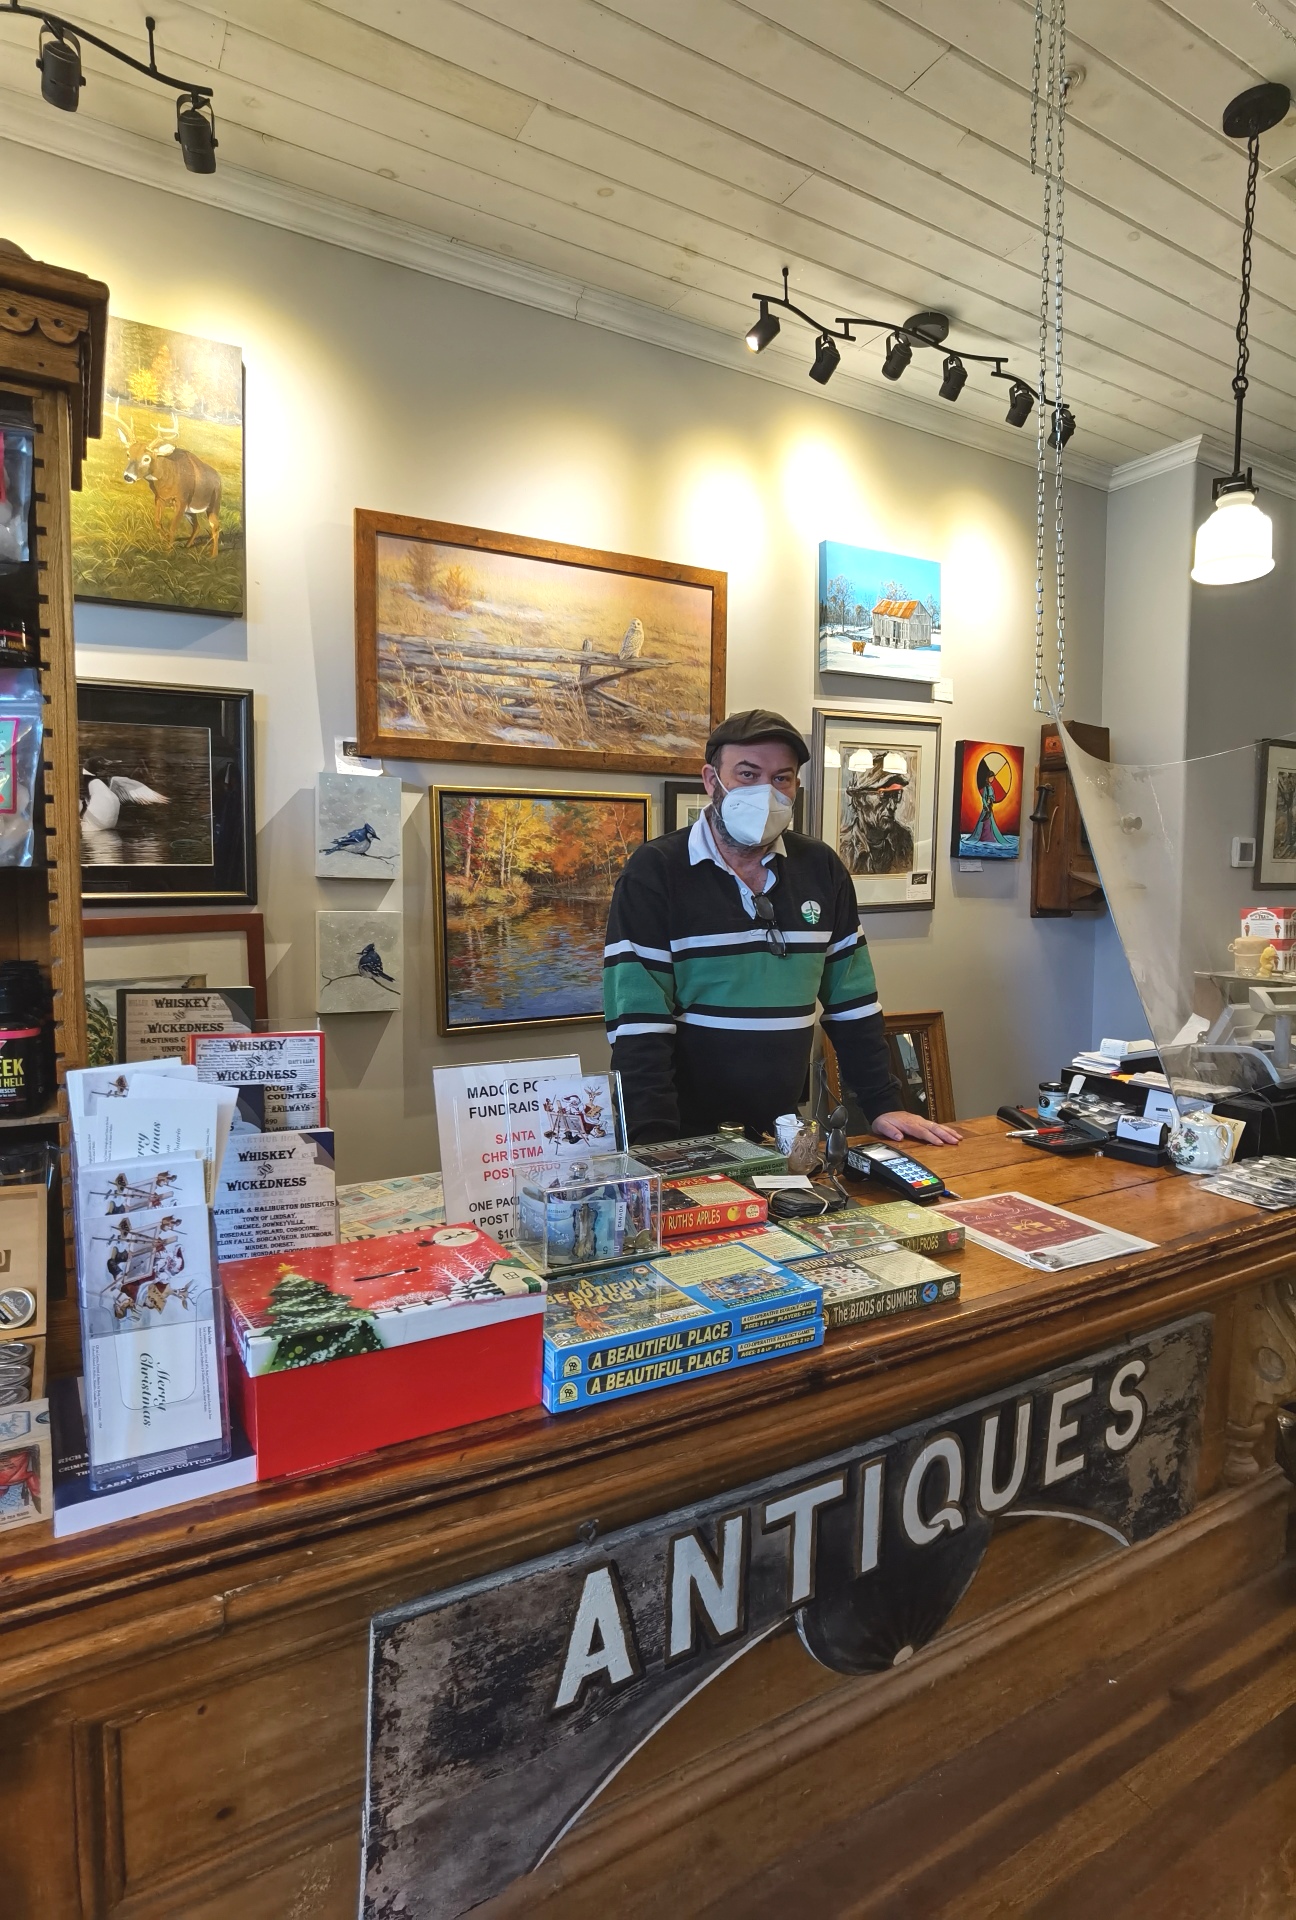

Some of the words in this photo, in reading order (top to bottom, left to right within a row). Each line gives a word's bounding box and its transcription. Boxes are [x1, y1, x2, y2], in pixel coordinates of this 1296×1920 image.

[154, 997, 211, 1008] WHISKEY
[147, 1022, 224, 1033] WICKEDNESS
[229, 1039, 287, 1052] WHISKEY
[4, 1077, 25, 1087] HELL
[217, 1069, 297, 1081] WICKEDNESS
[495, 1130, 536, 1144] SANTA
[238, 1148, 296, 1162] WHISKEY
[482, 1146, 543, 1164] CHRSTMA
[226, 1177, 307, 1191] WICKEDNESS
[254, 1204, 299, 1212] HALIBURTON
[469, 1200, 493, 1212] ONE
[479, 1213, 509, 1227] POST
[668, 1213, 694, 1230] RUTH'S
[697, 1209, 721, 1226] APPLES
[801, 1256, 835, 1270] BIRDS
[580, 1279, 594, 1290] A
[547, 1279, 646, 1305] BEAUTIFUL
[572, 1290, 635, 1309] PLACE
[833, 1306, 848, 1323] The
[850, 1299, 875, 1319] BIRDS
[876, 1295, 884, 1313] of
[886, 1289, 918, 1310] SUMMER
[591, 1352, 602, 1369] A
[607, 1334, 683, 1366] BEAUTIFUL
[687, 1322, 729, 1346] PLACE
[591, 1378, 601, 1394] A
[606, 1359, 683, 1391] BEAUTIFUL
[687, 1347, 730, 1371] PLACE
[140, 1352, 154, 1429] Christmas
[154, 1361, 171, 1412] Merry
[136, 1466, 175, 1480] DONALD
[177, 1457, 212, 1470] COTTON
[554, 1360, 1146, 1710] ANTIQUES
